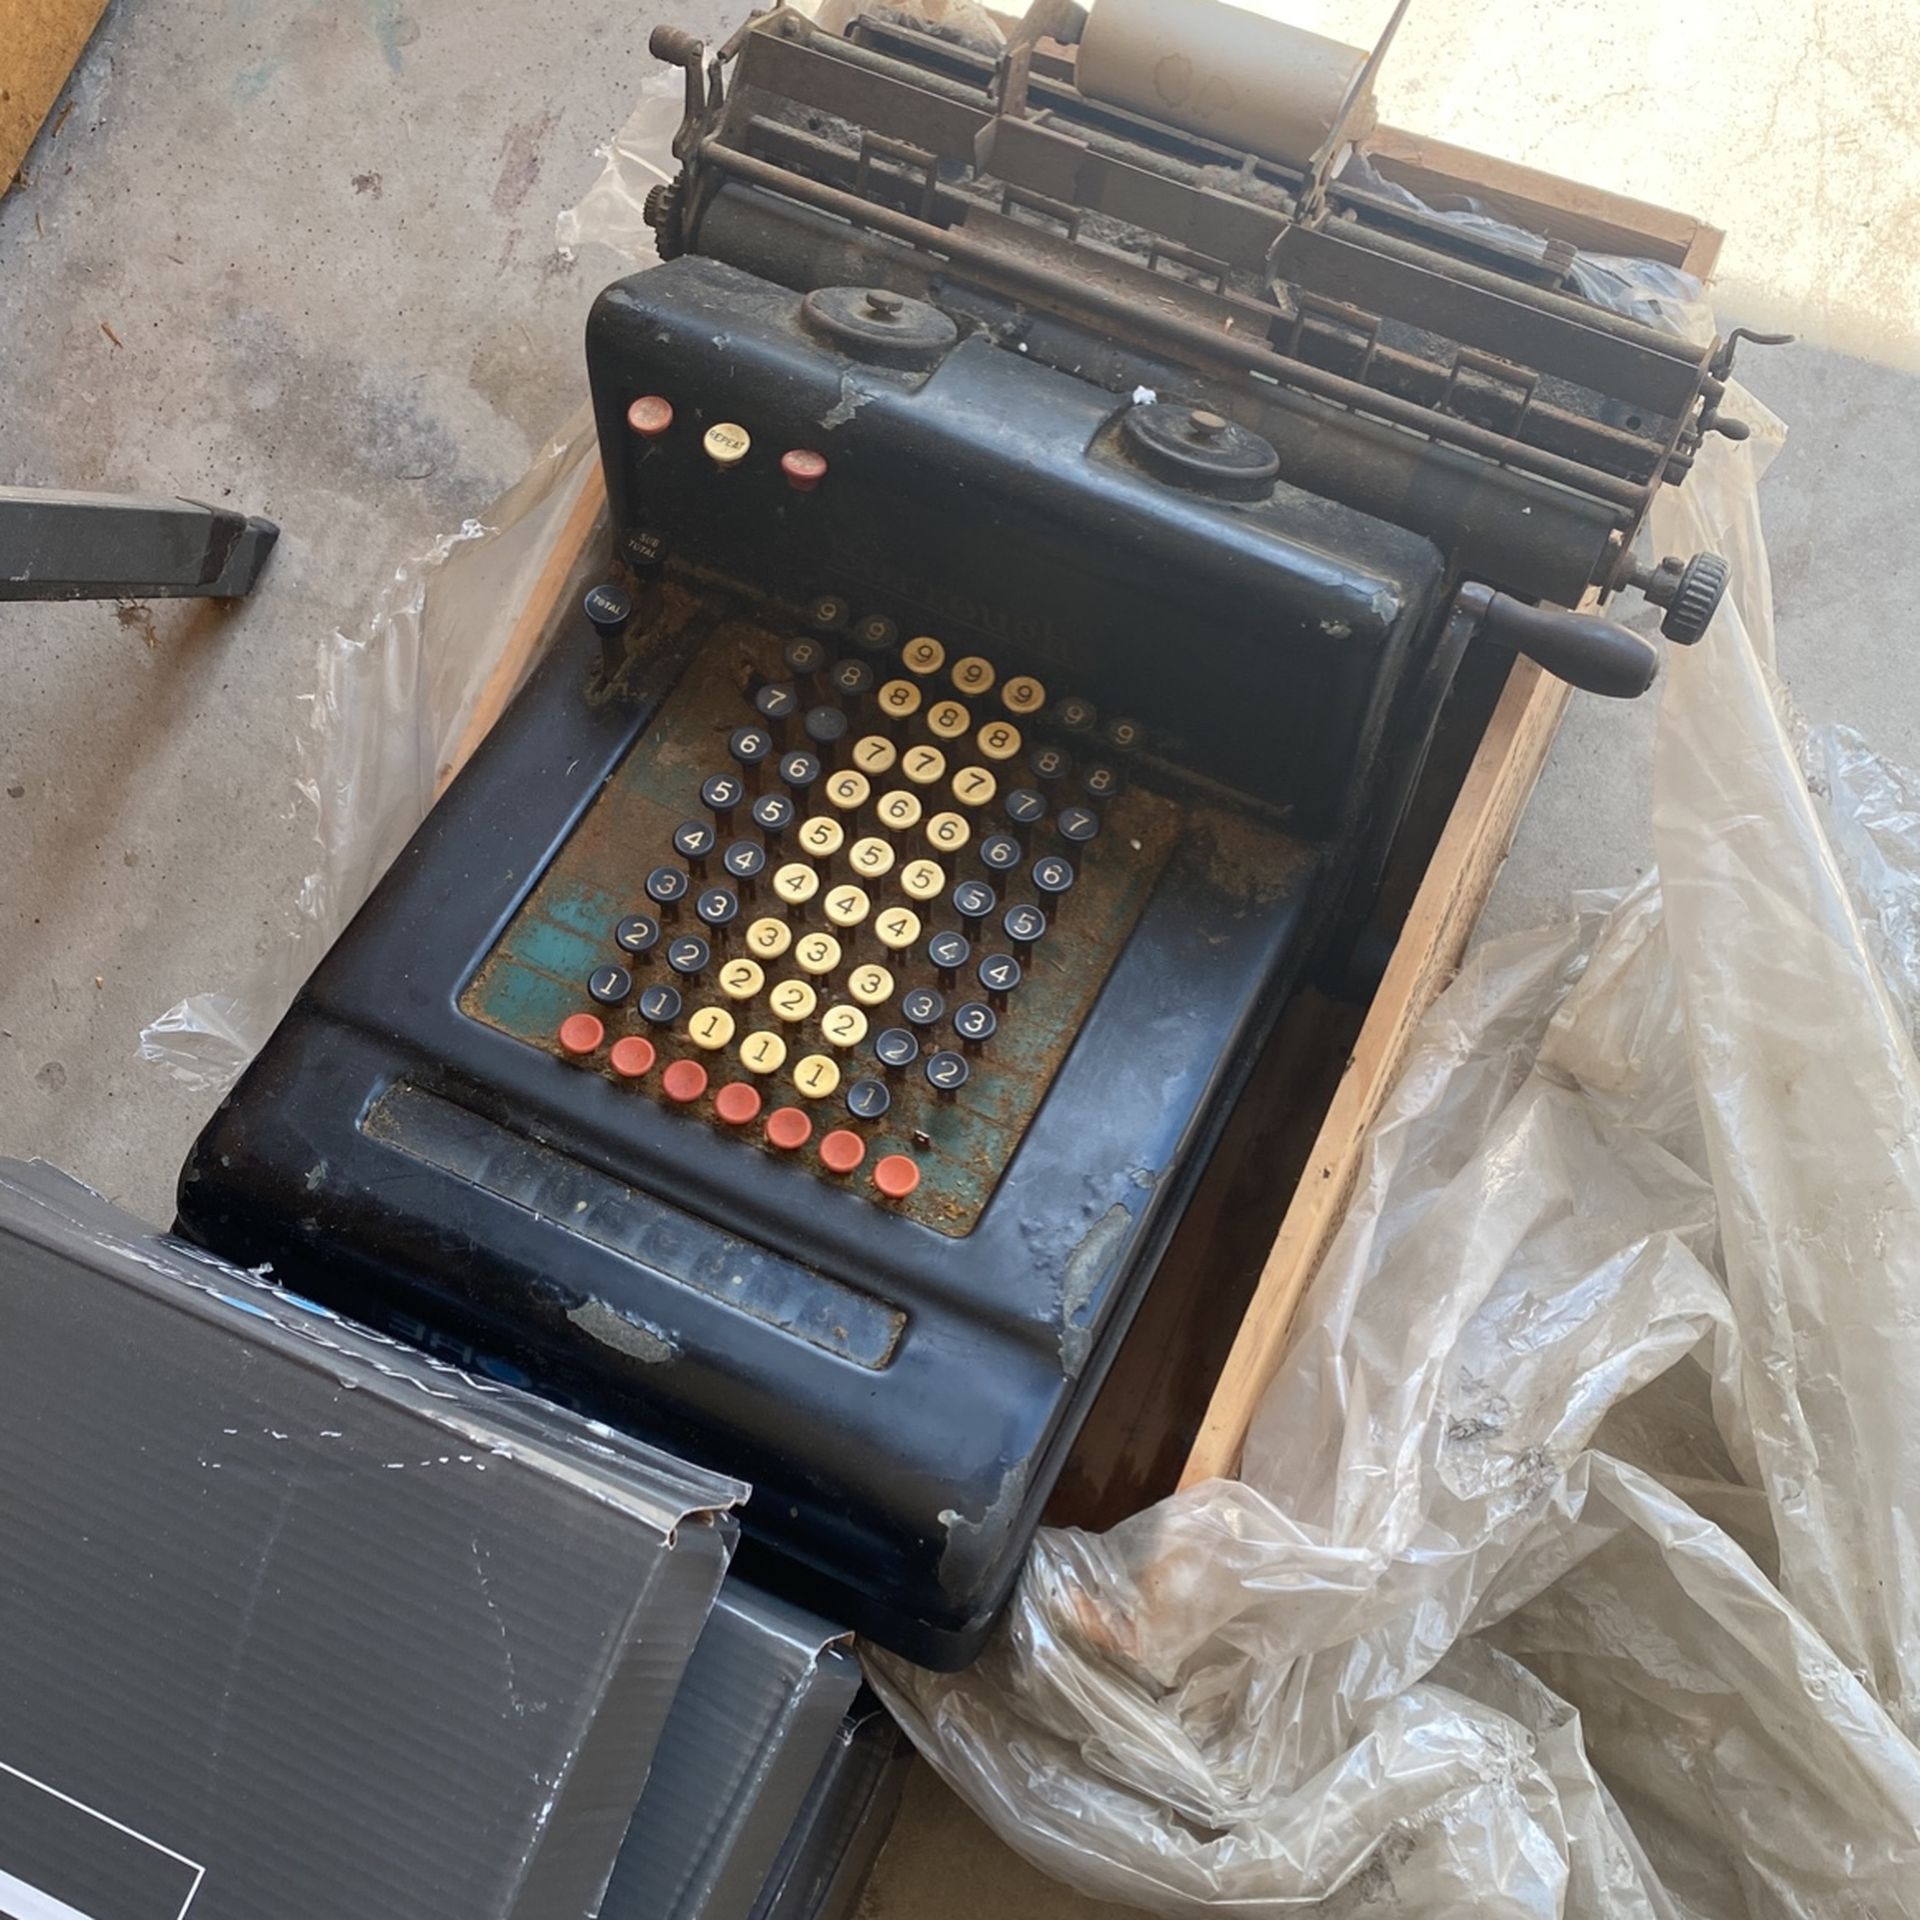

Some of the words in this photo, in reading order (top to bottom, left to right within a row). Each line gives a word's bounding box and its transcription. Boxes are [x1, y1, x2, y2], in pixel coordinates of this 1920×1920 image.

[627, 540, 657, 559] TOTAL
[639, 532, 661, 547] SUB
[592, 594, 622, 615] TOTAL
[791, 644, 813, 663] 8
[914, 645, 935, 663] 9
[840, 666, 861, 686] 8
[964, 664, 984, 682] 9
[767, 689, 787, 709] 7
[889, 687, 910, 707] 8
[1013, 684, 1034, 703] 9
[939, 707, 960, 727] 8
[739, 734, 761, 753] 6
[989, 730, 1010, 750] 8
[865, 741, 888, 762] 7
[915, 751, 937, 772] 7
[789, 758, 809, 778] 6
[1038, 752, 1060, 773] 8
[710, 779, 734, 802] 5
[837, 778, 859, 798] 6
[964, 772, 987, 794] 7
[1089, 770, 1110, 790] 8
[760, 801, 783, 822] 5
[889, 799, 909, 818] 6
[1016, 793, 1038, 814] 7
[937, 820, 959, 841] 6
[1067, 812, 1089, 833] 7
[683, 831, 704, 849] 4
[809, 824, 833, 845] 5
[735, 851, 754, 870] 4
[860, 845, 883, 866] 5
[990, 843, 1011, 862] 6
[656, 875, 677, 895] 3
[785, 874, 807, 892] 4
[911, 867, 935, 889] 5
[1042, 864, 1063, 885] 6
[706, 895, 728, 917] 3
[835, 895, 857, 915] 4
[962, 889, 985, 910] 5
[624, 922, 649, 945] 2
[887, 918, 908, 937] 4
[1013, 912, 1037, 935] 5
[757, 926, 779, 947] 3
[675, 944, 700, 966] 2
[806, 941, 829, 963] 3
[937, 940, 960, 961] 4
[599, 973, 617, 995] 1
[729, 967, 752, 989] 2
[860, 973, 882, 994] 3
[989, 965, 1009, 983] 4
[647, 993, 667, 1015] 1
[779, 988, 805, 1011] 2
[912, 996, 933, 1017] 3
[701, 1015, 719, 1038] 1
[831, 1014, 855, 1037] 2
[964, 1010, 985, 1033] 3
[753, 1039, 770, 1063] 1
[884, 1038, 909, 1061] 2
[805, 1063, 825, 1087] 1
[935, 1060, 959, 1084] 2
[857, 1087, 876, 1110] 1
